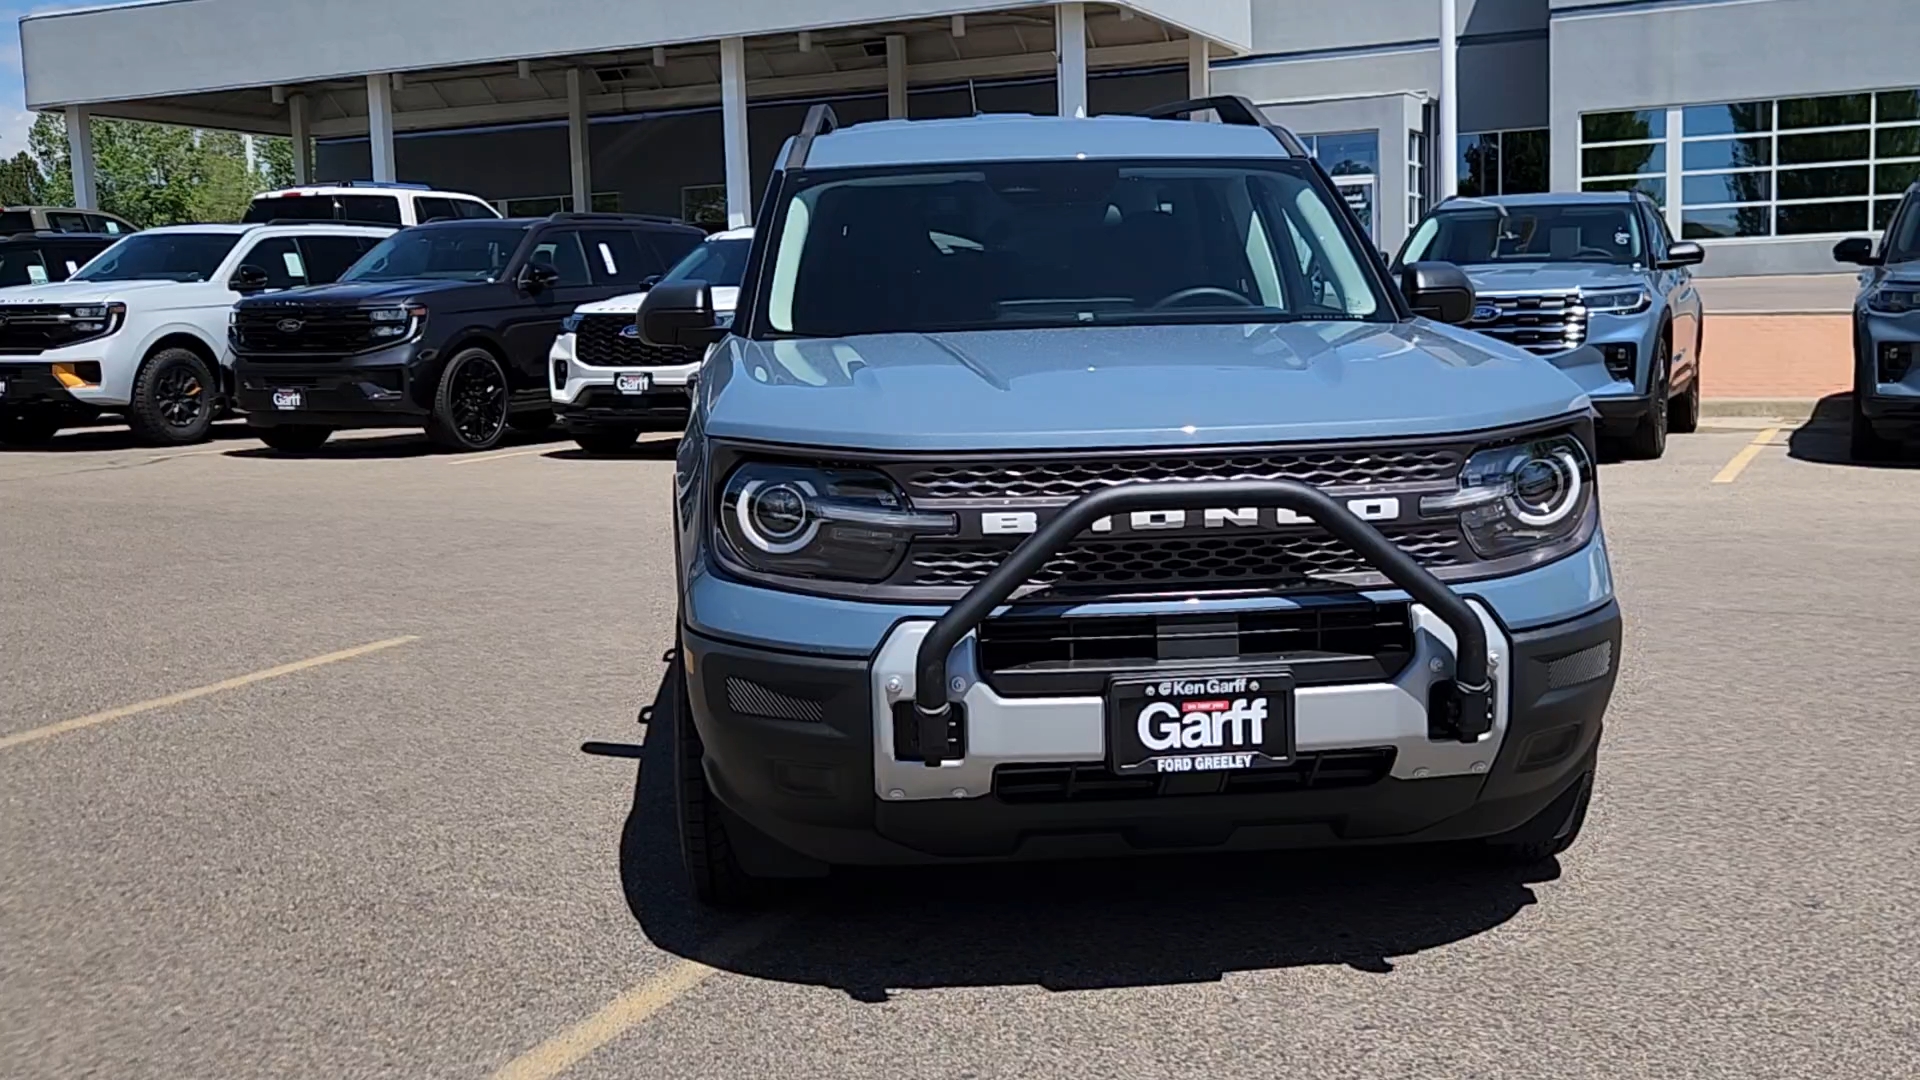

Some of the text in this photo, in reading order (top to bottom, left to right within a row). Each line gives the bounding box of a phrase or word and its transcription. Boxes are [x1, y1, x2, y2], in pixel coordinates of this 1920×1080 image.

[981, 497, 1400, 534] BONO
[1173, 678, 1247, 696] Ken Garff
[1138, 698, 1267, 750] Garff
[1157, 754, 1252, 772] FORD GREELEY
